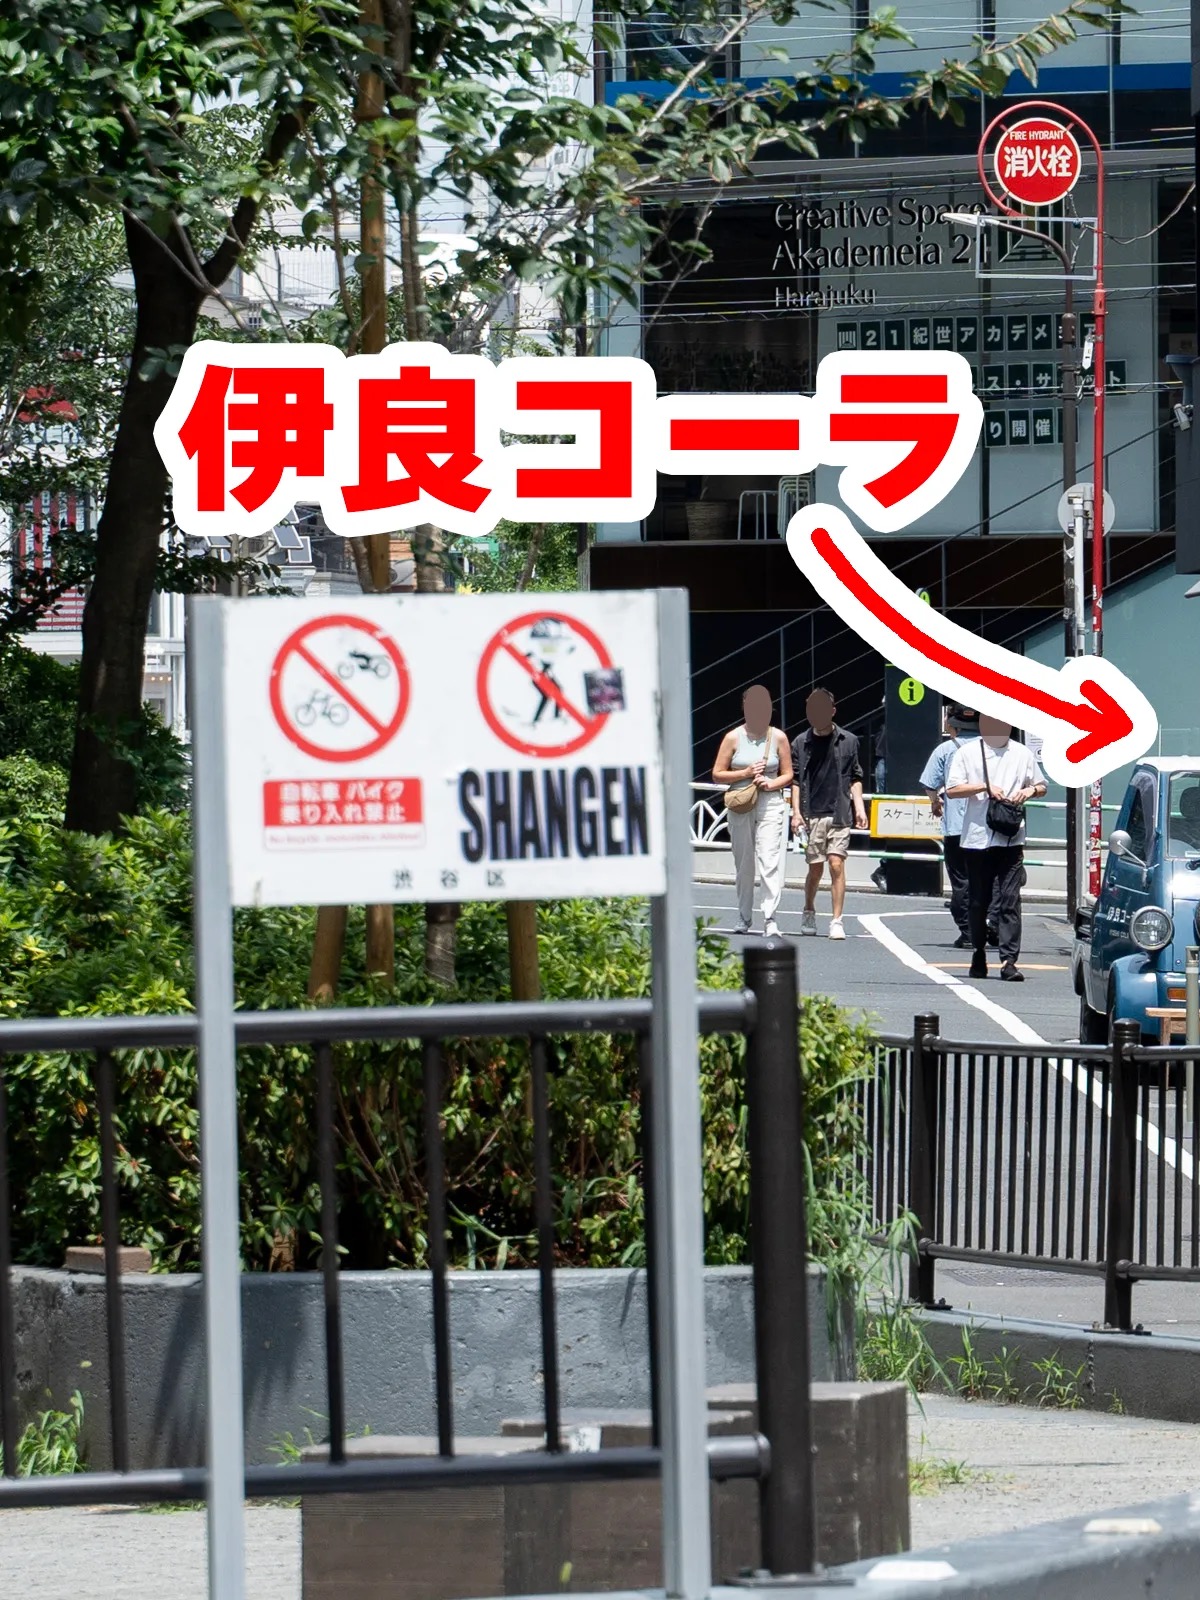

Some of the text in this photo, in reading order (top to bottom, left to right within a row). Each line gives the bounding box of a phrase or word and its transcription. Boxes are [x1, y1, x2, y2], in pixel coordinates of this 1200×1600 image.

[1009, 130, 1065, 141] FIRE HYDRANT
[1003, 145, 1074, 178] 消火栓
[774, 198, 988, 233] Creative Space
[772, 233, 988, 271] Akademeia 21
[774, 283, 877, 311] Harajuku
[280, 779, 405, 803] 自転車 バイク
[279, 802, 407, 825] 乗り入れ禁止
[457, 765, 650, 863] SHANGEN
[393, 867, 506, 890] 渋谷区
